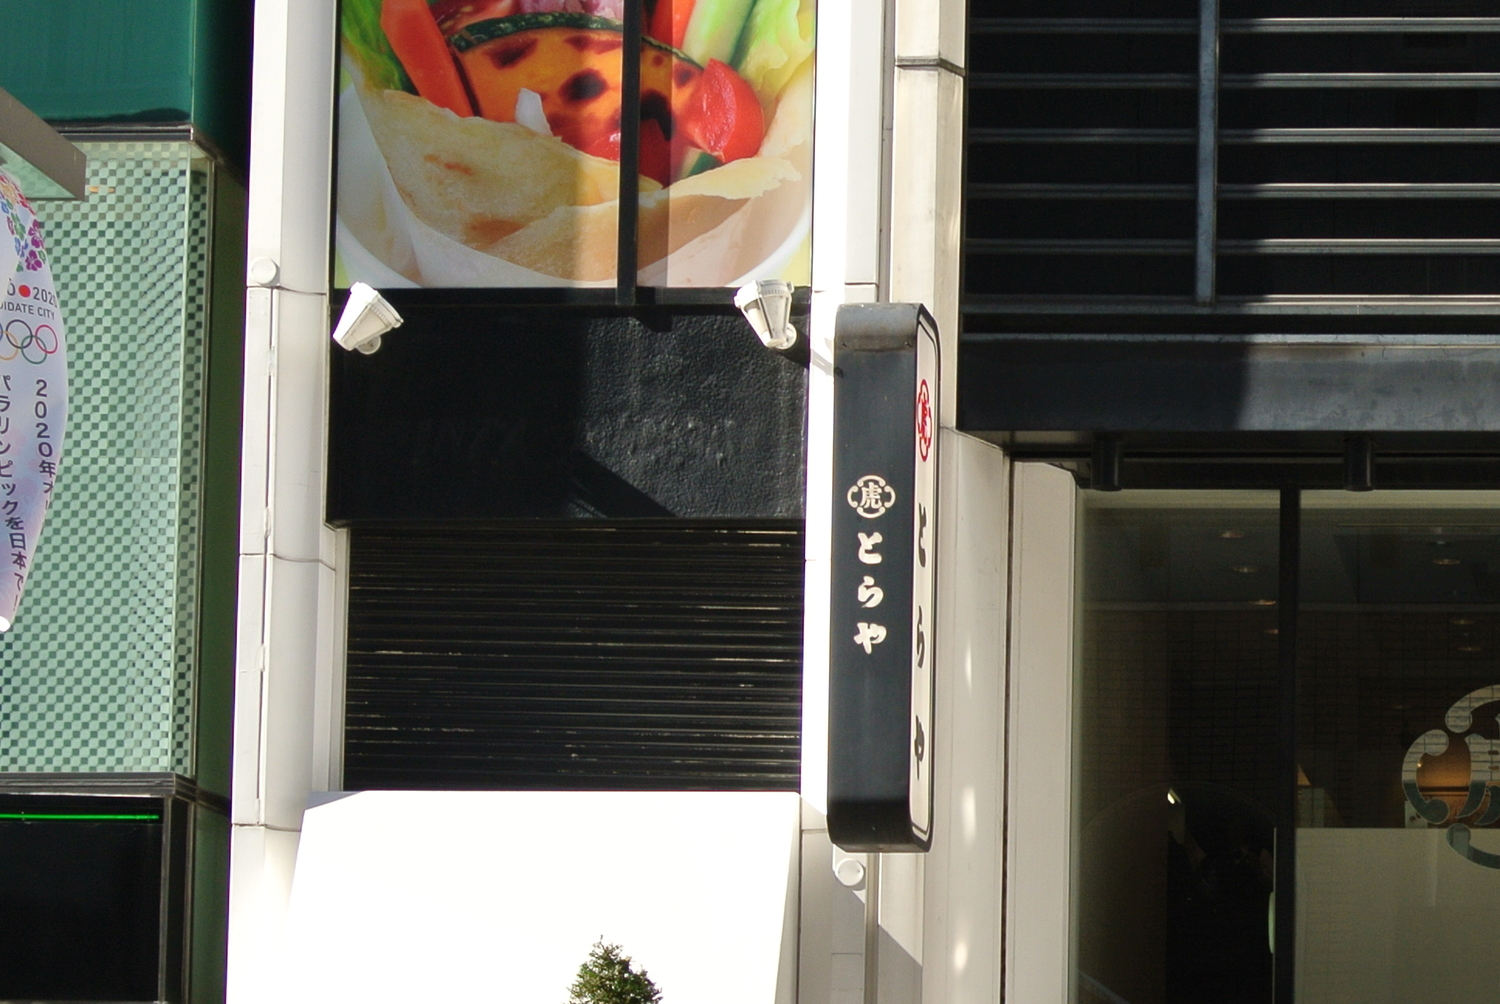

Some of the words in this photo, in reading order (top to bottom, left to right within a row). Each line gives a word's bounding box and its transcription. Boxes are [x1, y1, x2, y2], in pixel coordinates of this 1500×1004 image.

[37, 306, 55, 320] CITY
[860, 481, 883, 509] 虎
[853, 531, 887, 655] とらや
[914, 502, 928, 781] とらや
